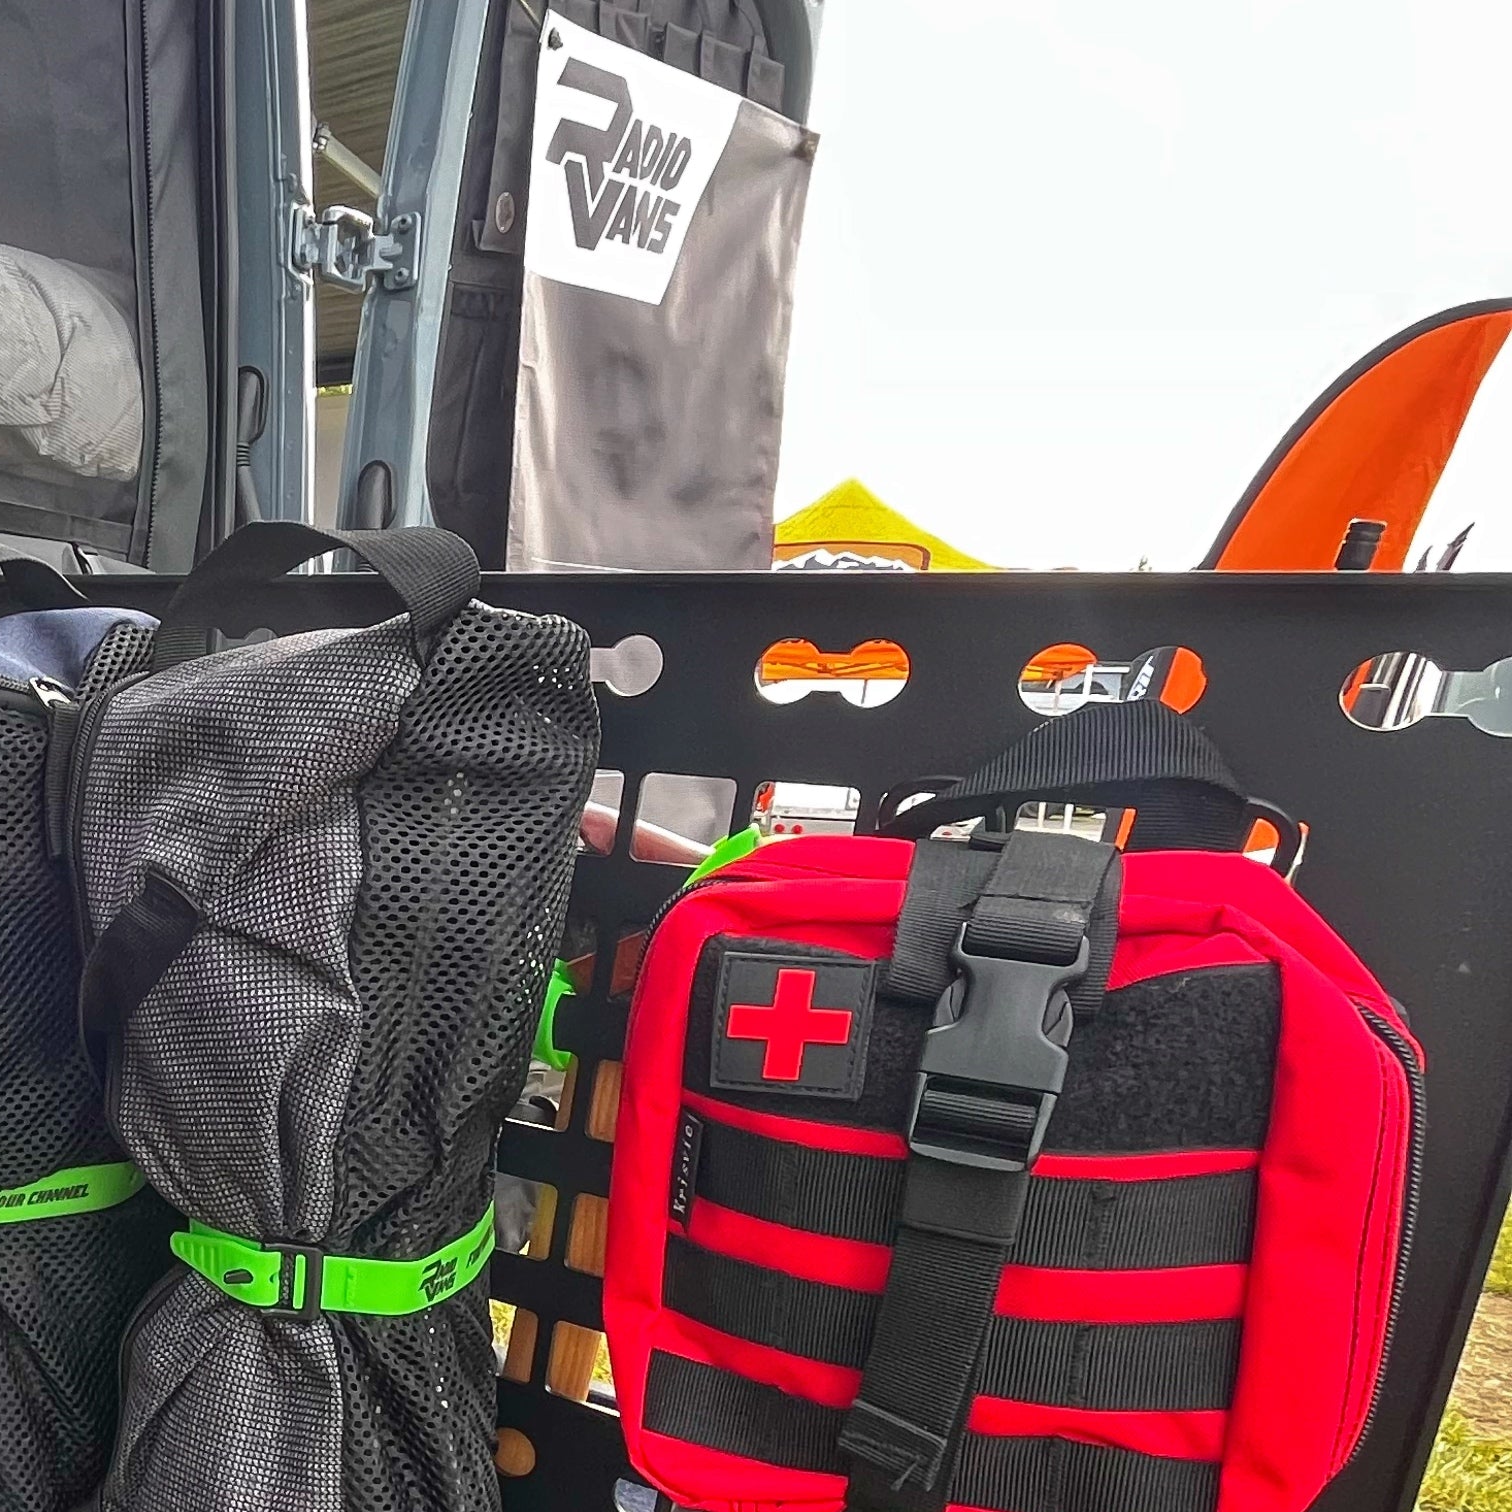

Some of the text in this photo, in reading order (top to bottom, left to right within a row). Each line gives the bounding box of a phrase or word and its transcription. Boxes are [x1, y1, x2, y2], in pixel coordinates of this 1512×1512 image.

[545, 57, 692, 191] RADIO
[565, 160, 681, 254] VANS
[27, 1184, 89, 1206] CHANNEL
